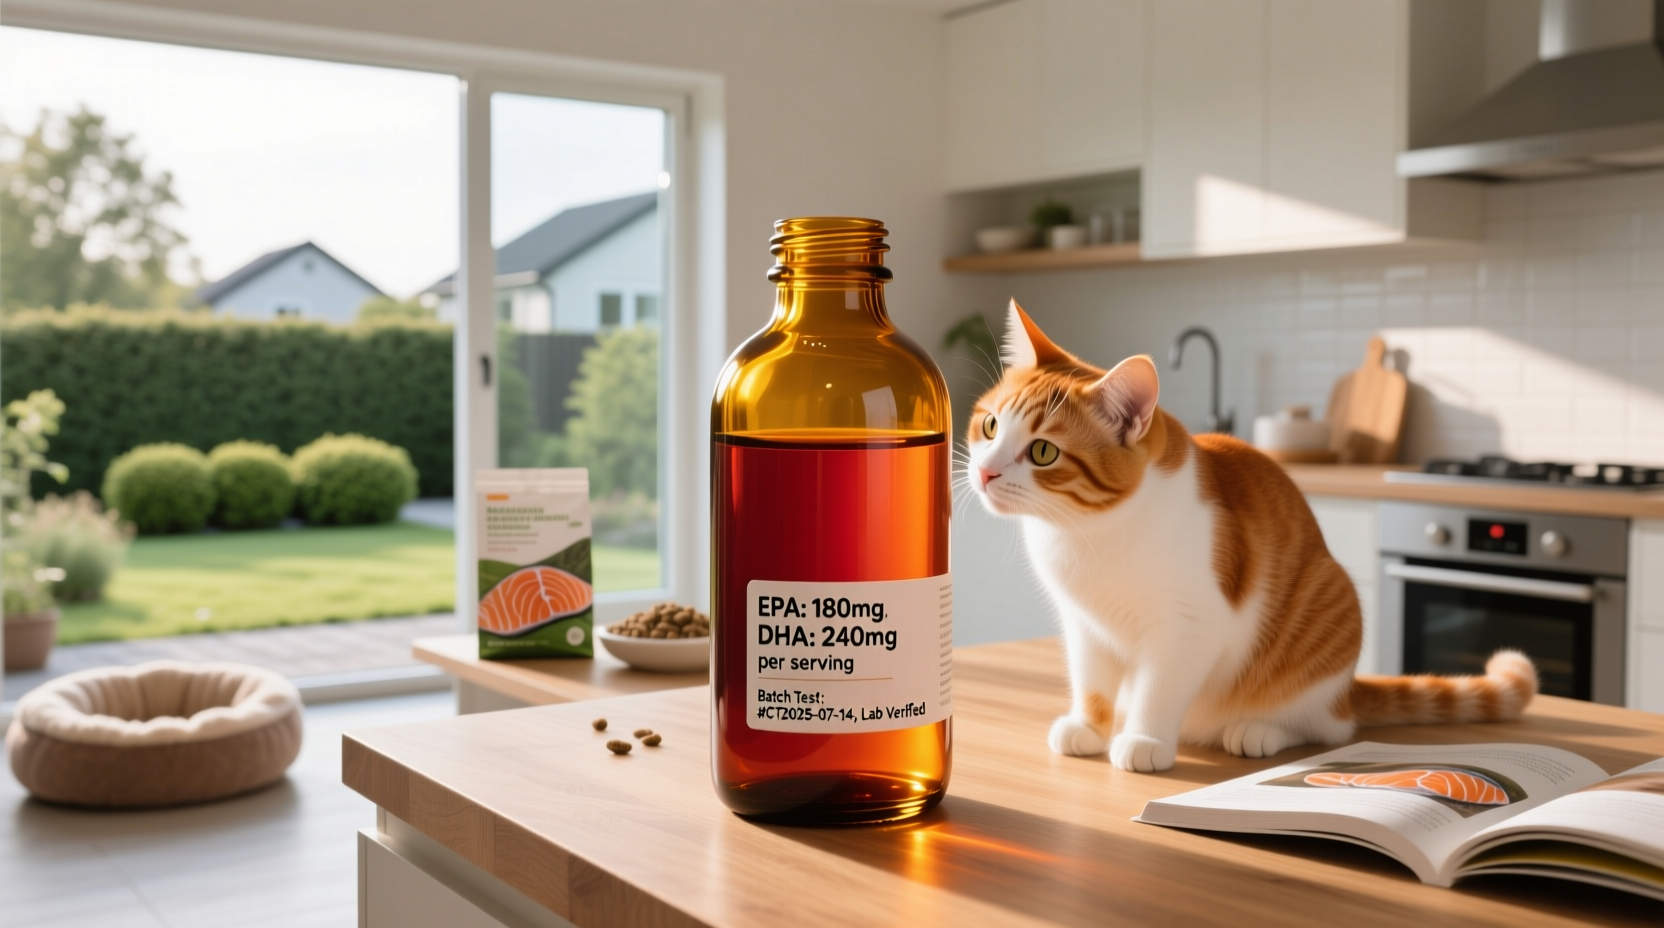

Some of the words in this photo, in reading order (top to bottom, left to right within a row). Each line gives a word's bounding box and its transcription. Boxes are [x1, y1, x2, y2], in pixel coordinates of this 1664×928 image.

[758, 596, 807, 618] EPA:
[758, 624, 816, 647] DHA:
[821, 626, 897, 651] 240mg
[758, 655, 785, 673] per
[790, 654, 854, 675] serving
[758, 689, 791, 704] Batch
[793, 690, 825, 705] Test:
[861, 706, 883, 721] Lab
